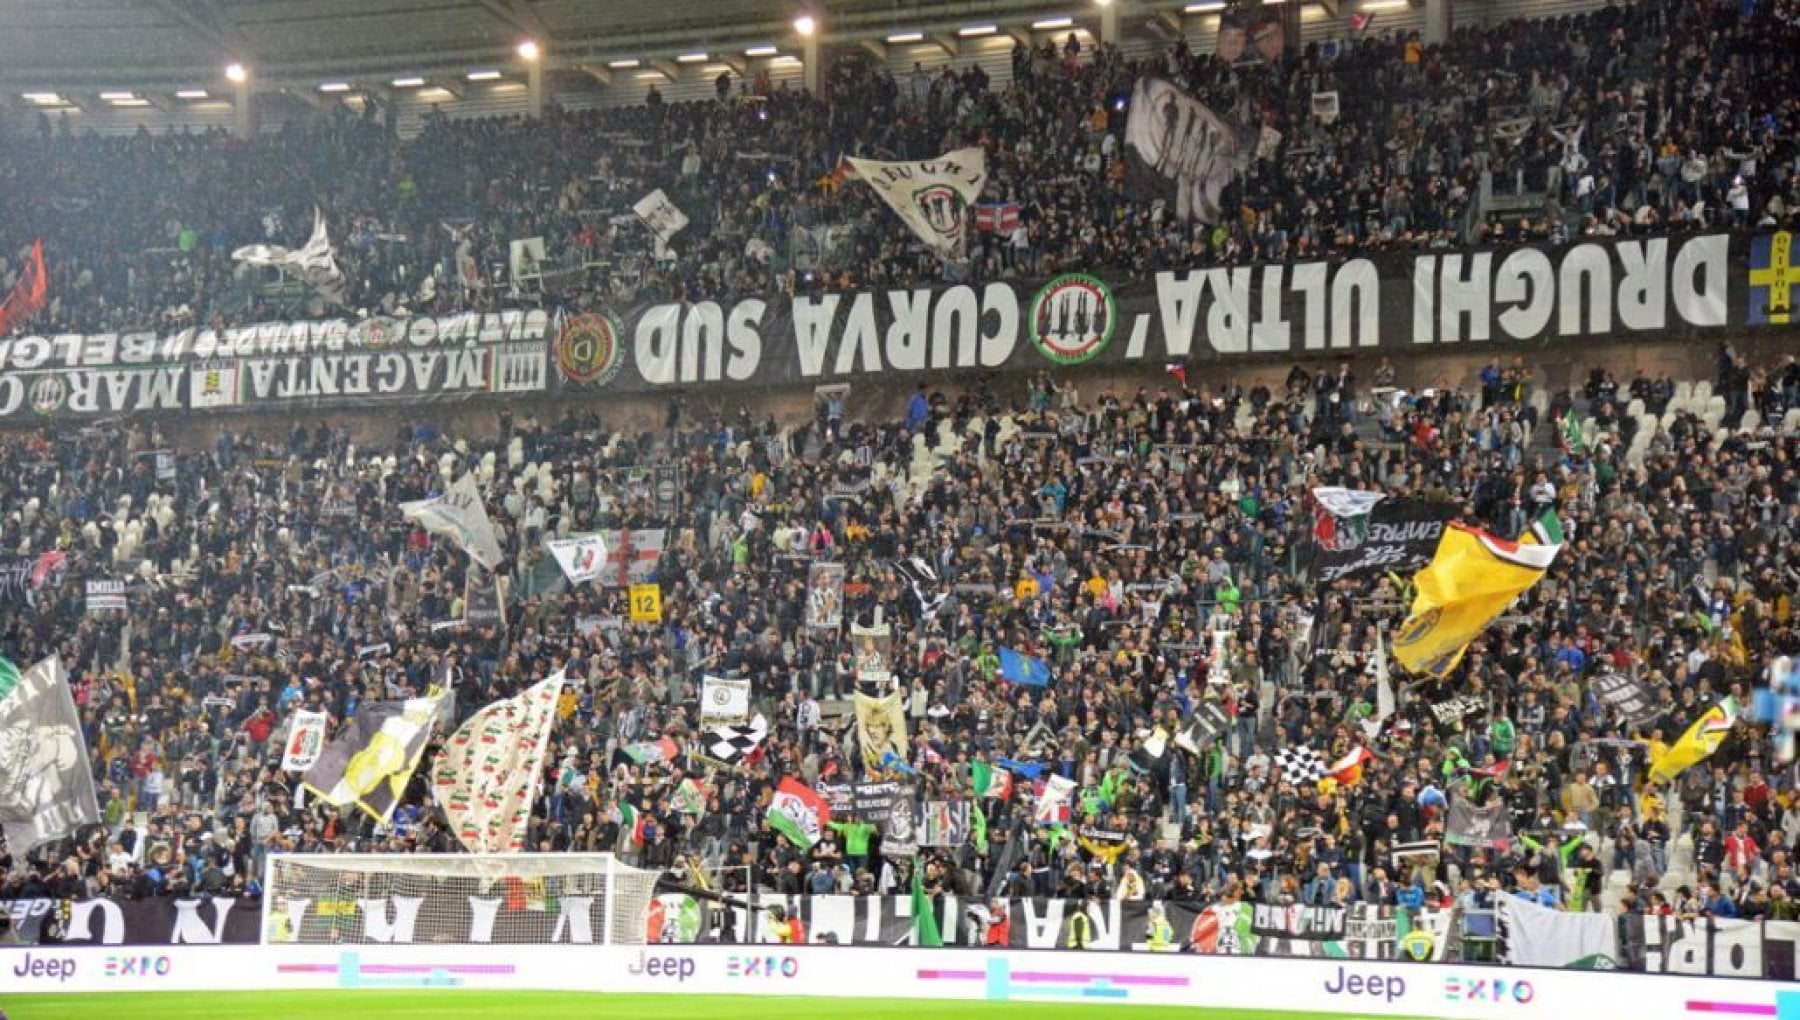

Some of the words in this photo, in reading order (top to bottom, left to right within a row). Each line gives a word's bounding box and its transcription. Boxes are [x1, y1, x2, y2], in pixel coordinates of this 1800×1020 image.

[1413, 234, 1729, 343] DRUGHI
[635, 299, 767, 384] SUD
[793, 282, 1019, 376] CURVA
[247, 344, 493, 398] MAGENTA
[636, 594, 655, 613] 12
[14, 952, 76, 981] Jeep
[105, 955, 170, 977] EXPO
[629, 950, 695, 981] Jeep
[727, 956, 798, 978] EXPO
[1324, 966, 1406, 1002] Jeep
[1445, 977, 1533, 1005] EXPO
